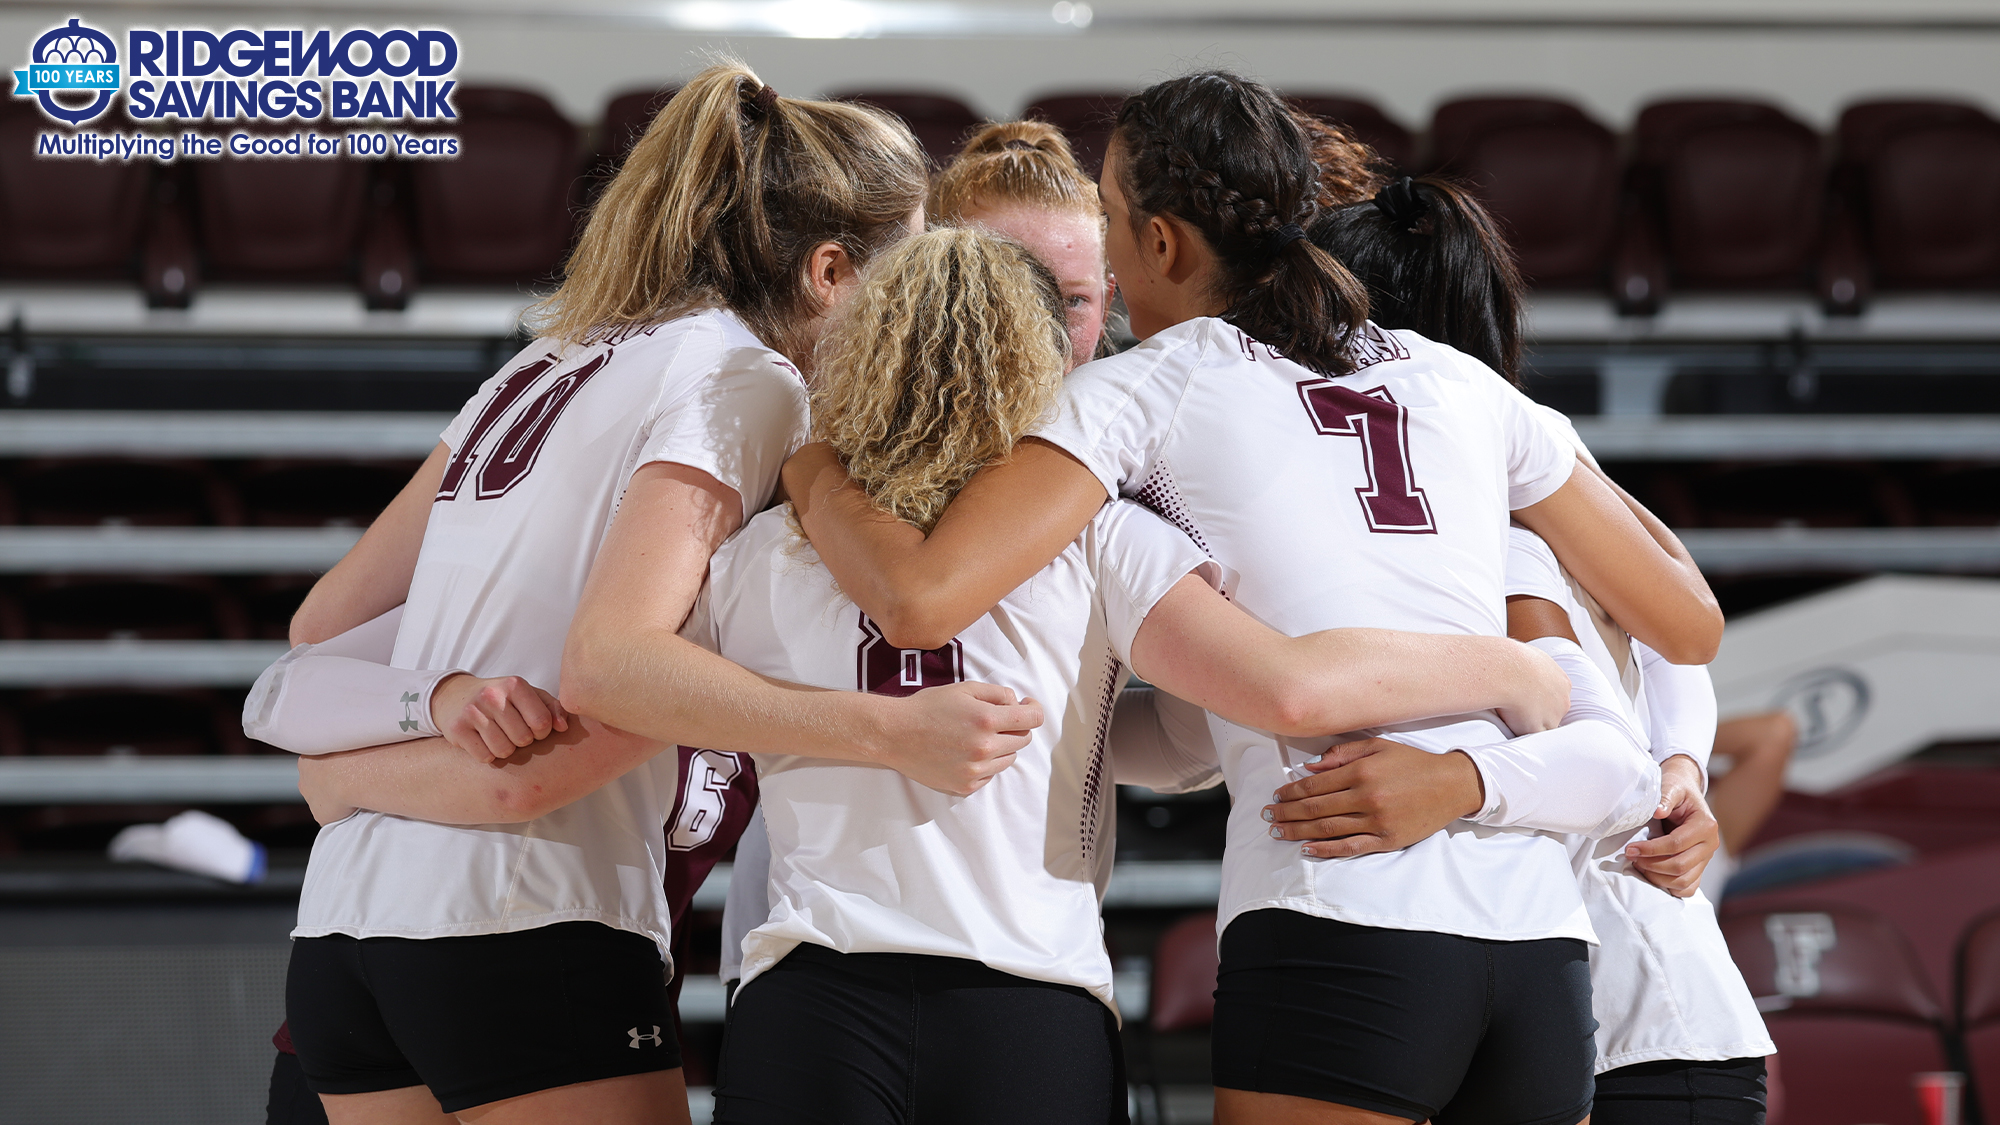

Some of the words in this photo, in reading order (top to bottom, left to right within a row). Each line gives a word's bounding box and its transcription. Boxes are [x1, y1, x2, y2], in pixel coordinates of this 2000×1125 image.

[434, 347, 614, 502] 10
[1296, 378, 1438, 535] 7
[667, 748, 742, 852] 6
